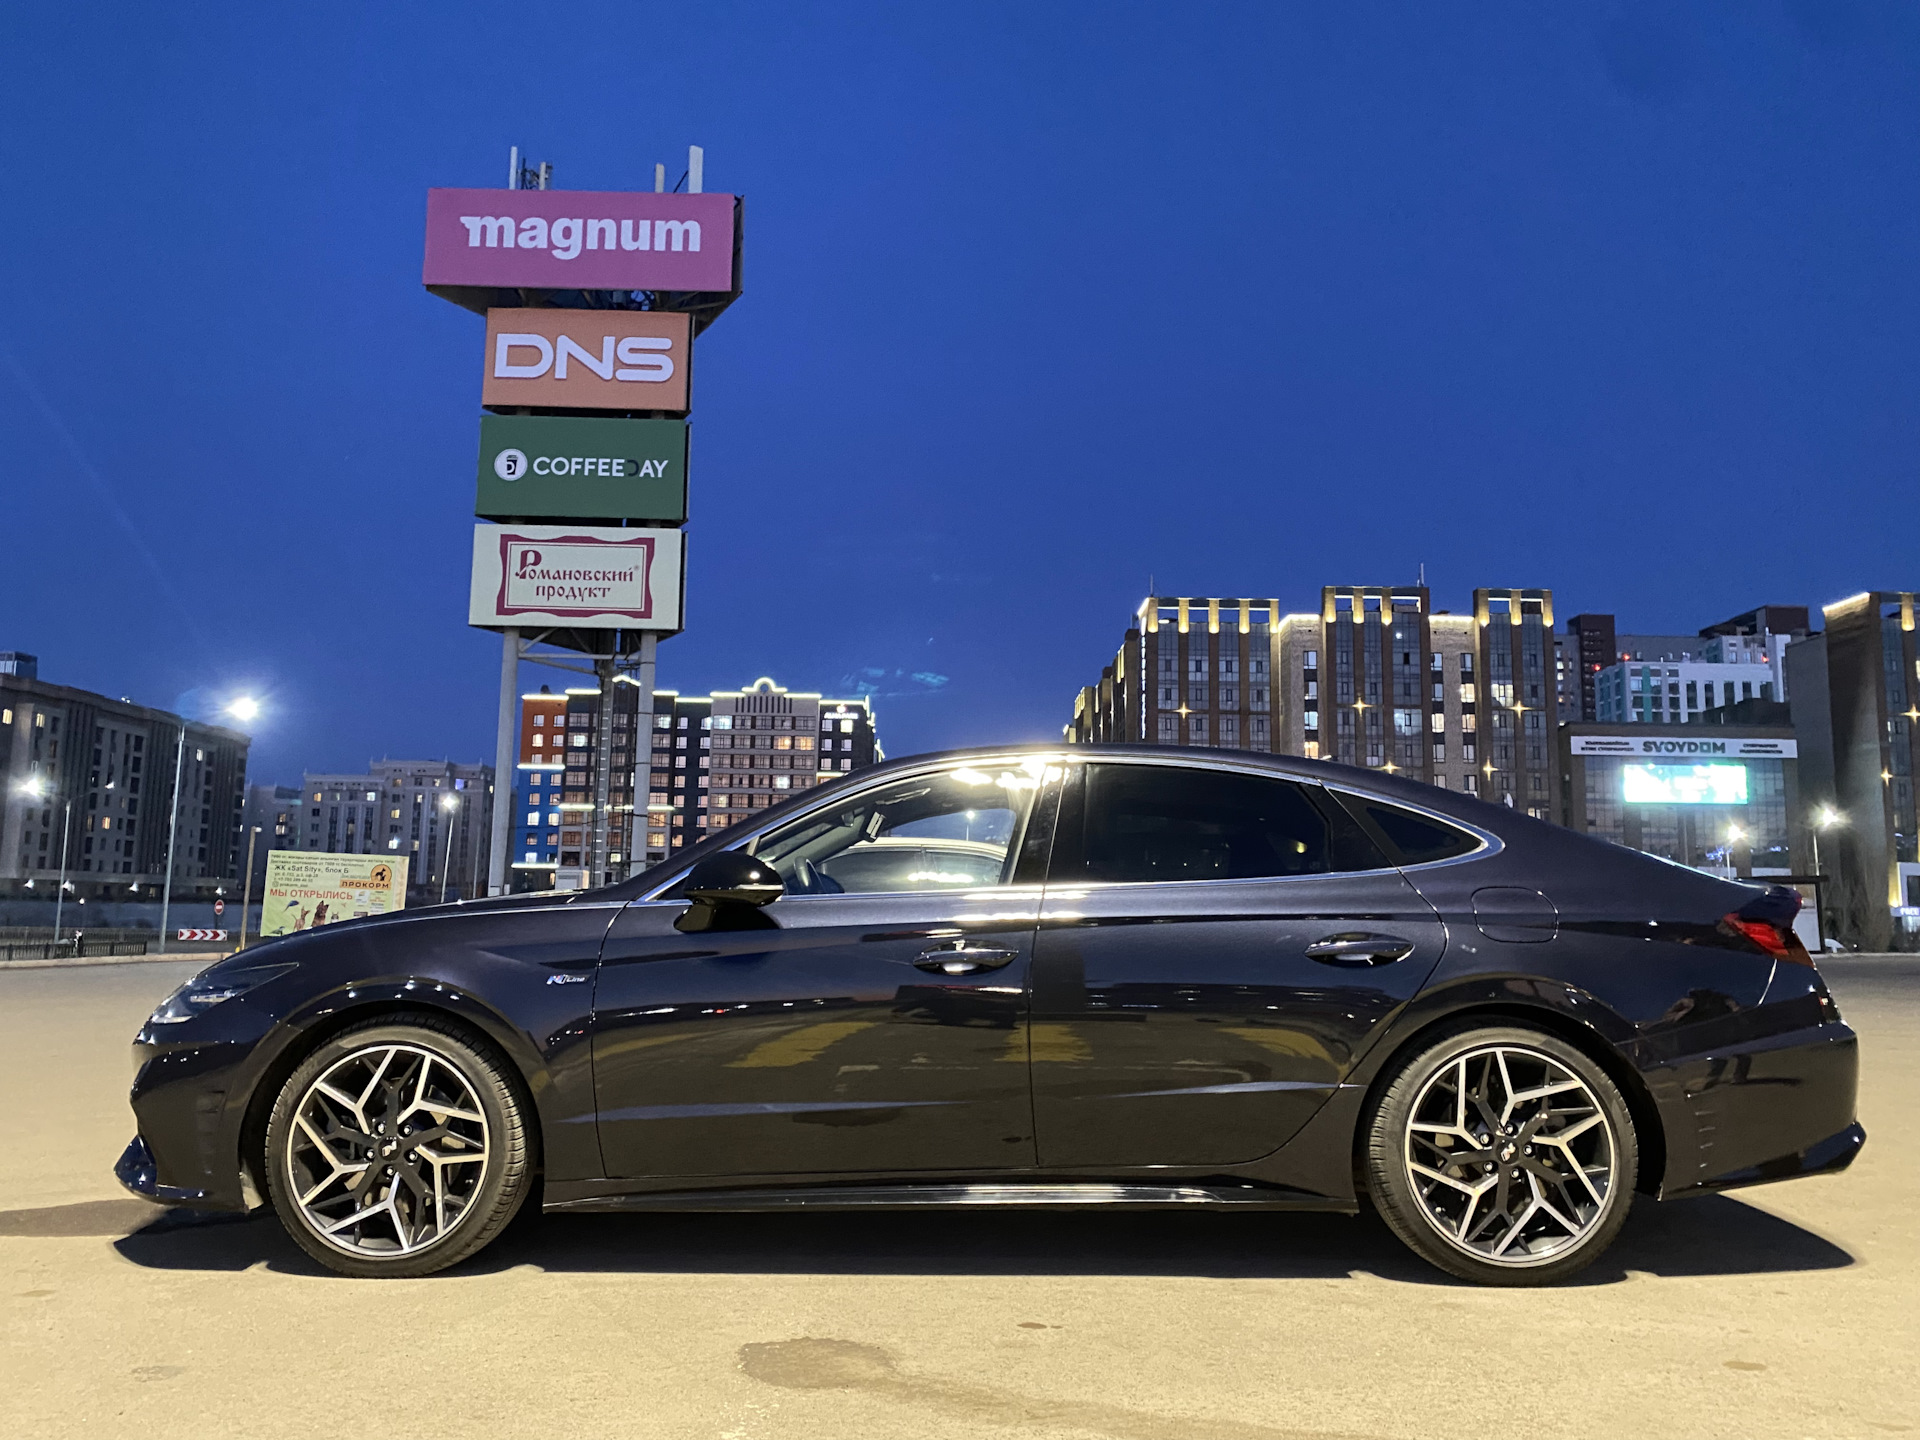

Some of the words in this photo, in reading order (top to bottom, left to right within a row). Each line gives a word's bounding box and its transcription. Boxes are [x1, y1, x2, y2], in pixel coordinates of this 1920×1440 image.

[459, 215, 701, 260] magnum
[494, 333, 674, 382] DNS
[515, 549, 633, 582] Романовский
[535, 584, 611, 601] продукт
[1642, 740, 1726, 754] SVOYDOM
[341, 881, 389, 889] ПРОКОРМ
[270, 888, 287, 896] МЫ
[290, 889, 353, 900] ОТКРЫЛИСЬ
